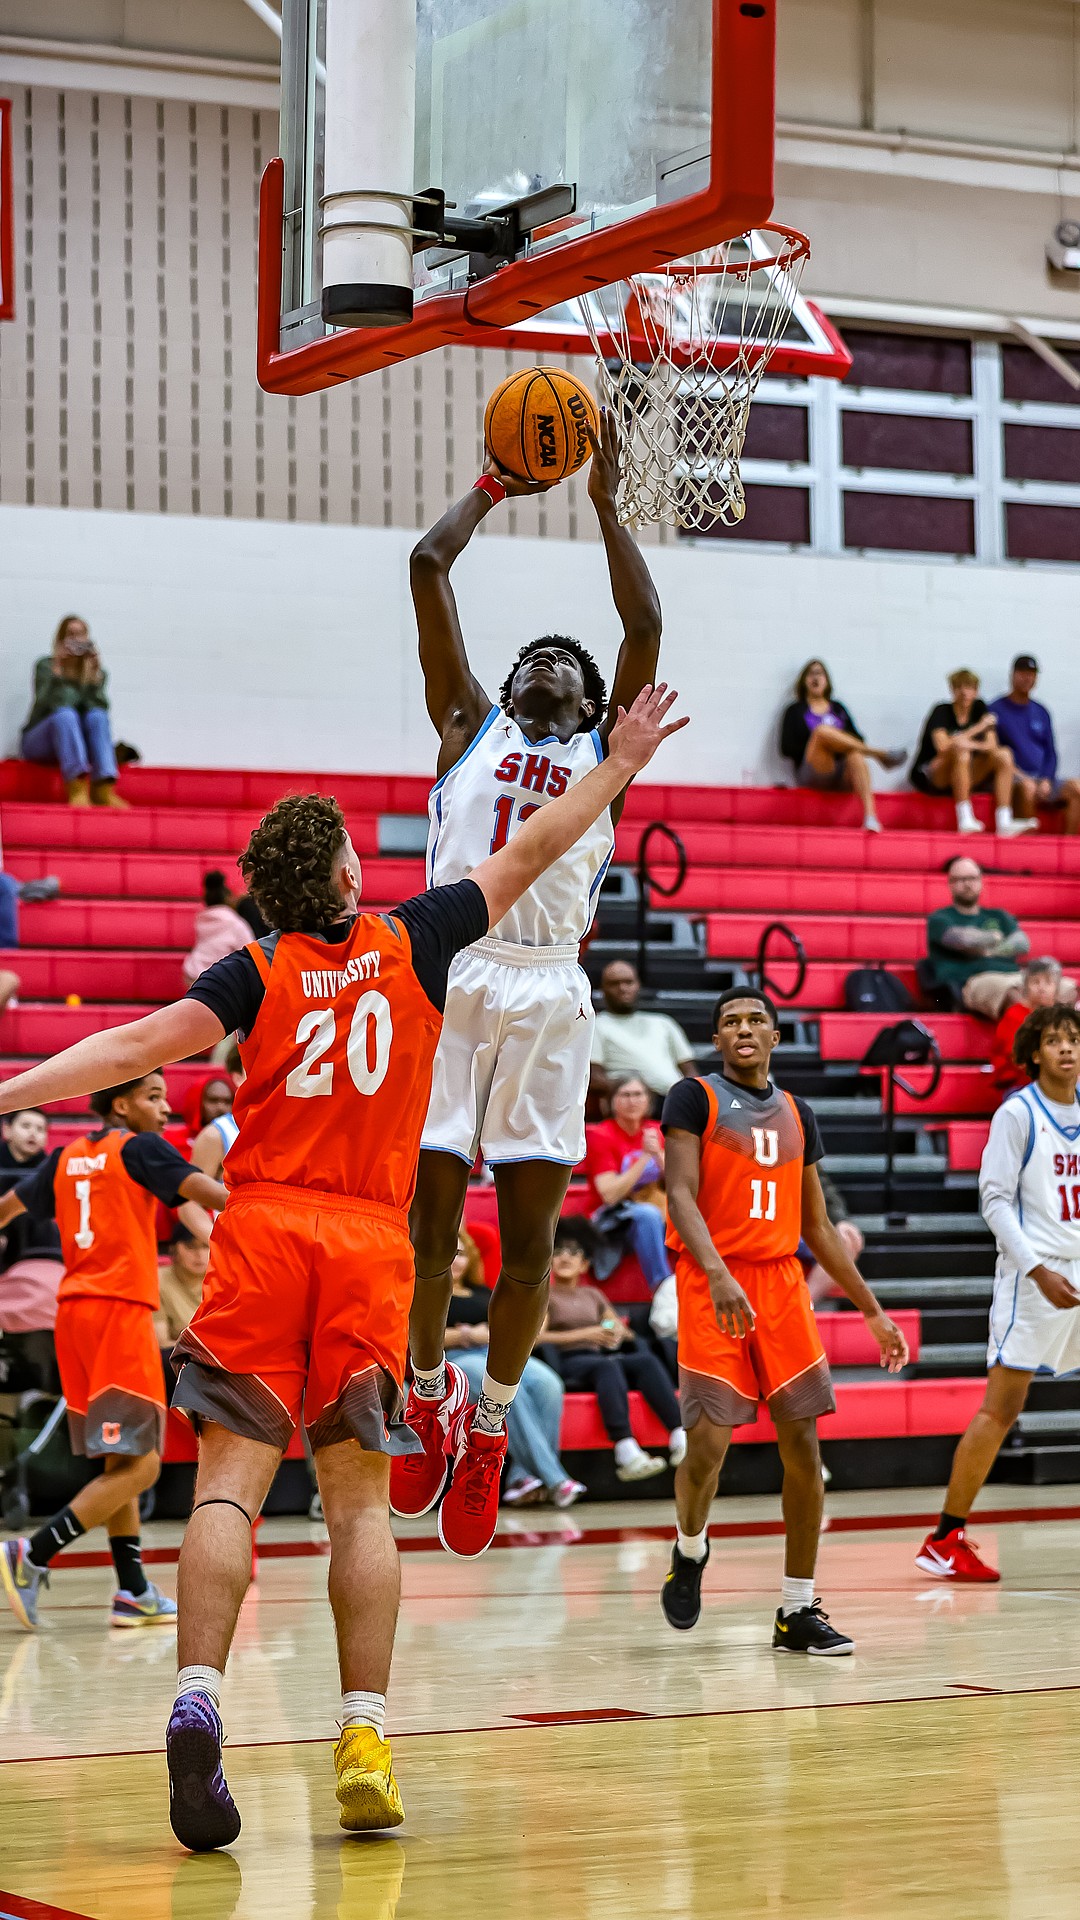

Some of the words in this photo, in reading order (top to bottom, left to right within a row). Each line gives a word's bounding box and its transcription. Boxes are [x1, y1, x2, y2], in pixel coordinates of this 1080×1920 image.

[537, 414, 557, 468] NCAA
[494, 752, 573, 798] SHS
[286, 989, 393, 1098] 20
[751, 1126, 779, 1168] U
[74, 1179, 95, 1249] 1
[749, 1179, 777, 1221] 11
